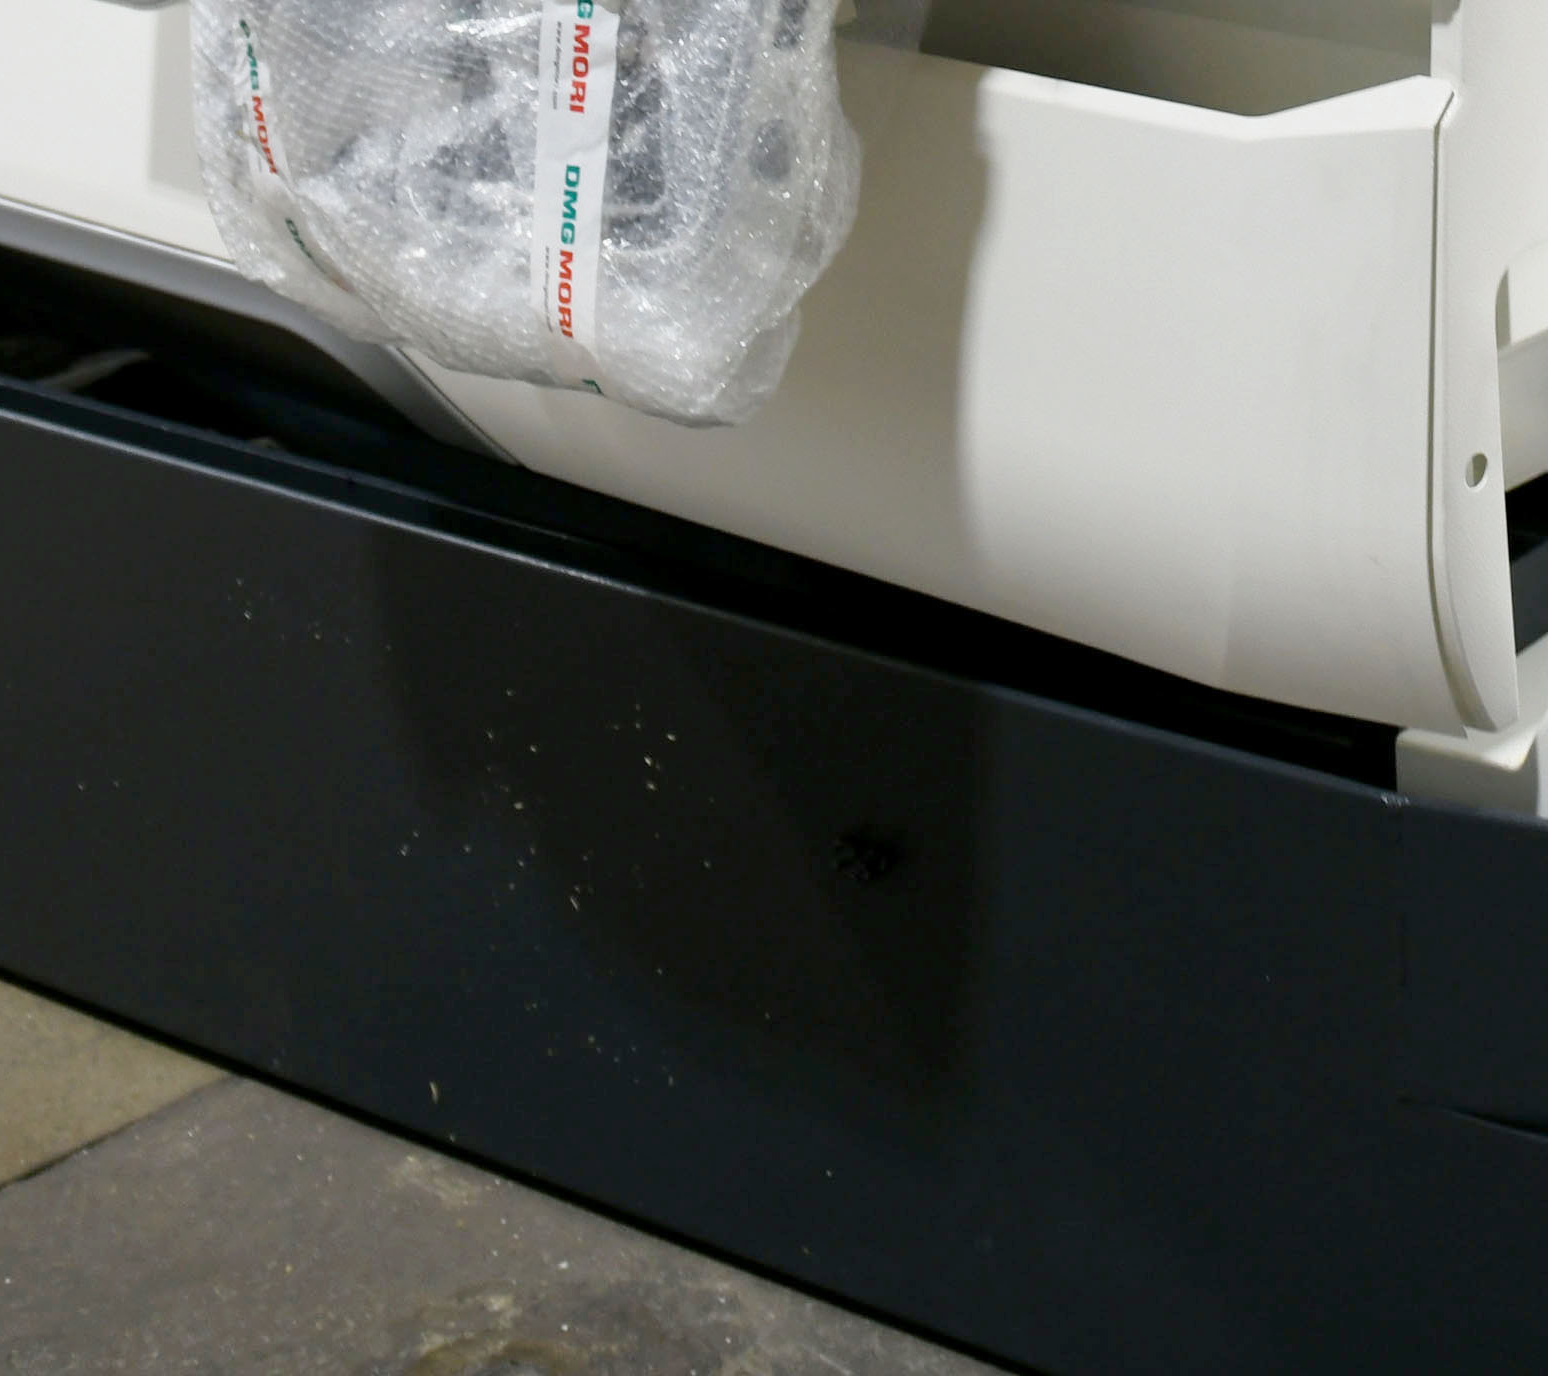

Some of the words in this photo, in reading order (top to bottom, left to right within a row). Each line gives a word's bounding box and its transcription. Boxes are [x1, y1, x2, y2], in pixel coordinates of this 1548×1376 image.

[570, 25, 590, 112] MORI
[561, 165, 580, 244] DMG
[559, 251, 573, 338] MORI
